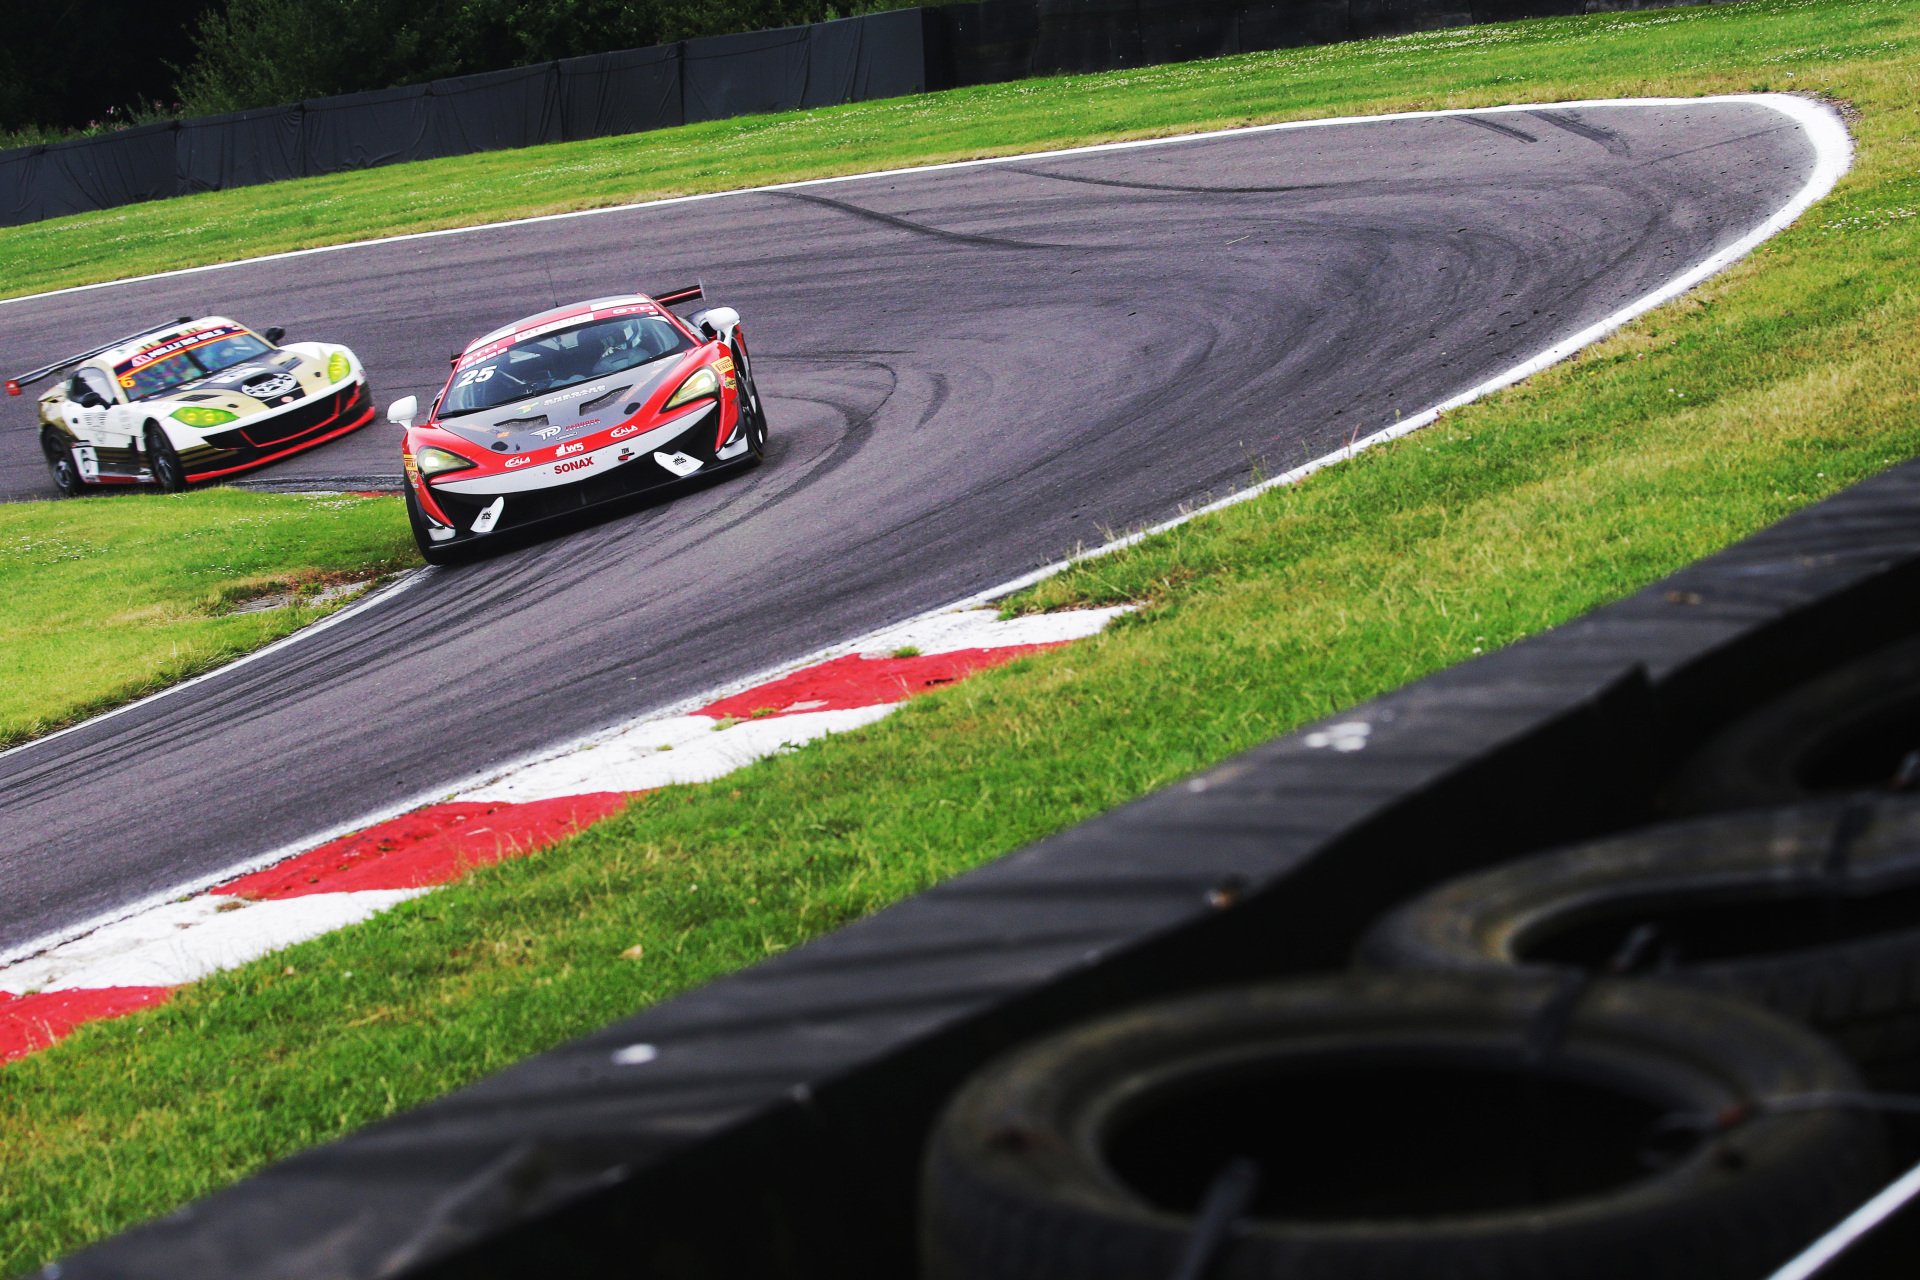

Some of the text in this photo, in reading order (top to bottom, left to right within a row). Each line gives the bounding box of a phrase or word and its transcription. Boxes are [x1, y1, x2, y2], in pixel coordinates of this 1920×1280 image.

[454, 365, 498, 389] 25
[610, 425, 638, 438] CALA
[504, 456, 531, 468] CALA
[554, 456, 594, 475] SONAX
